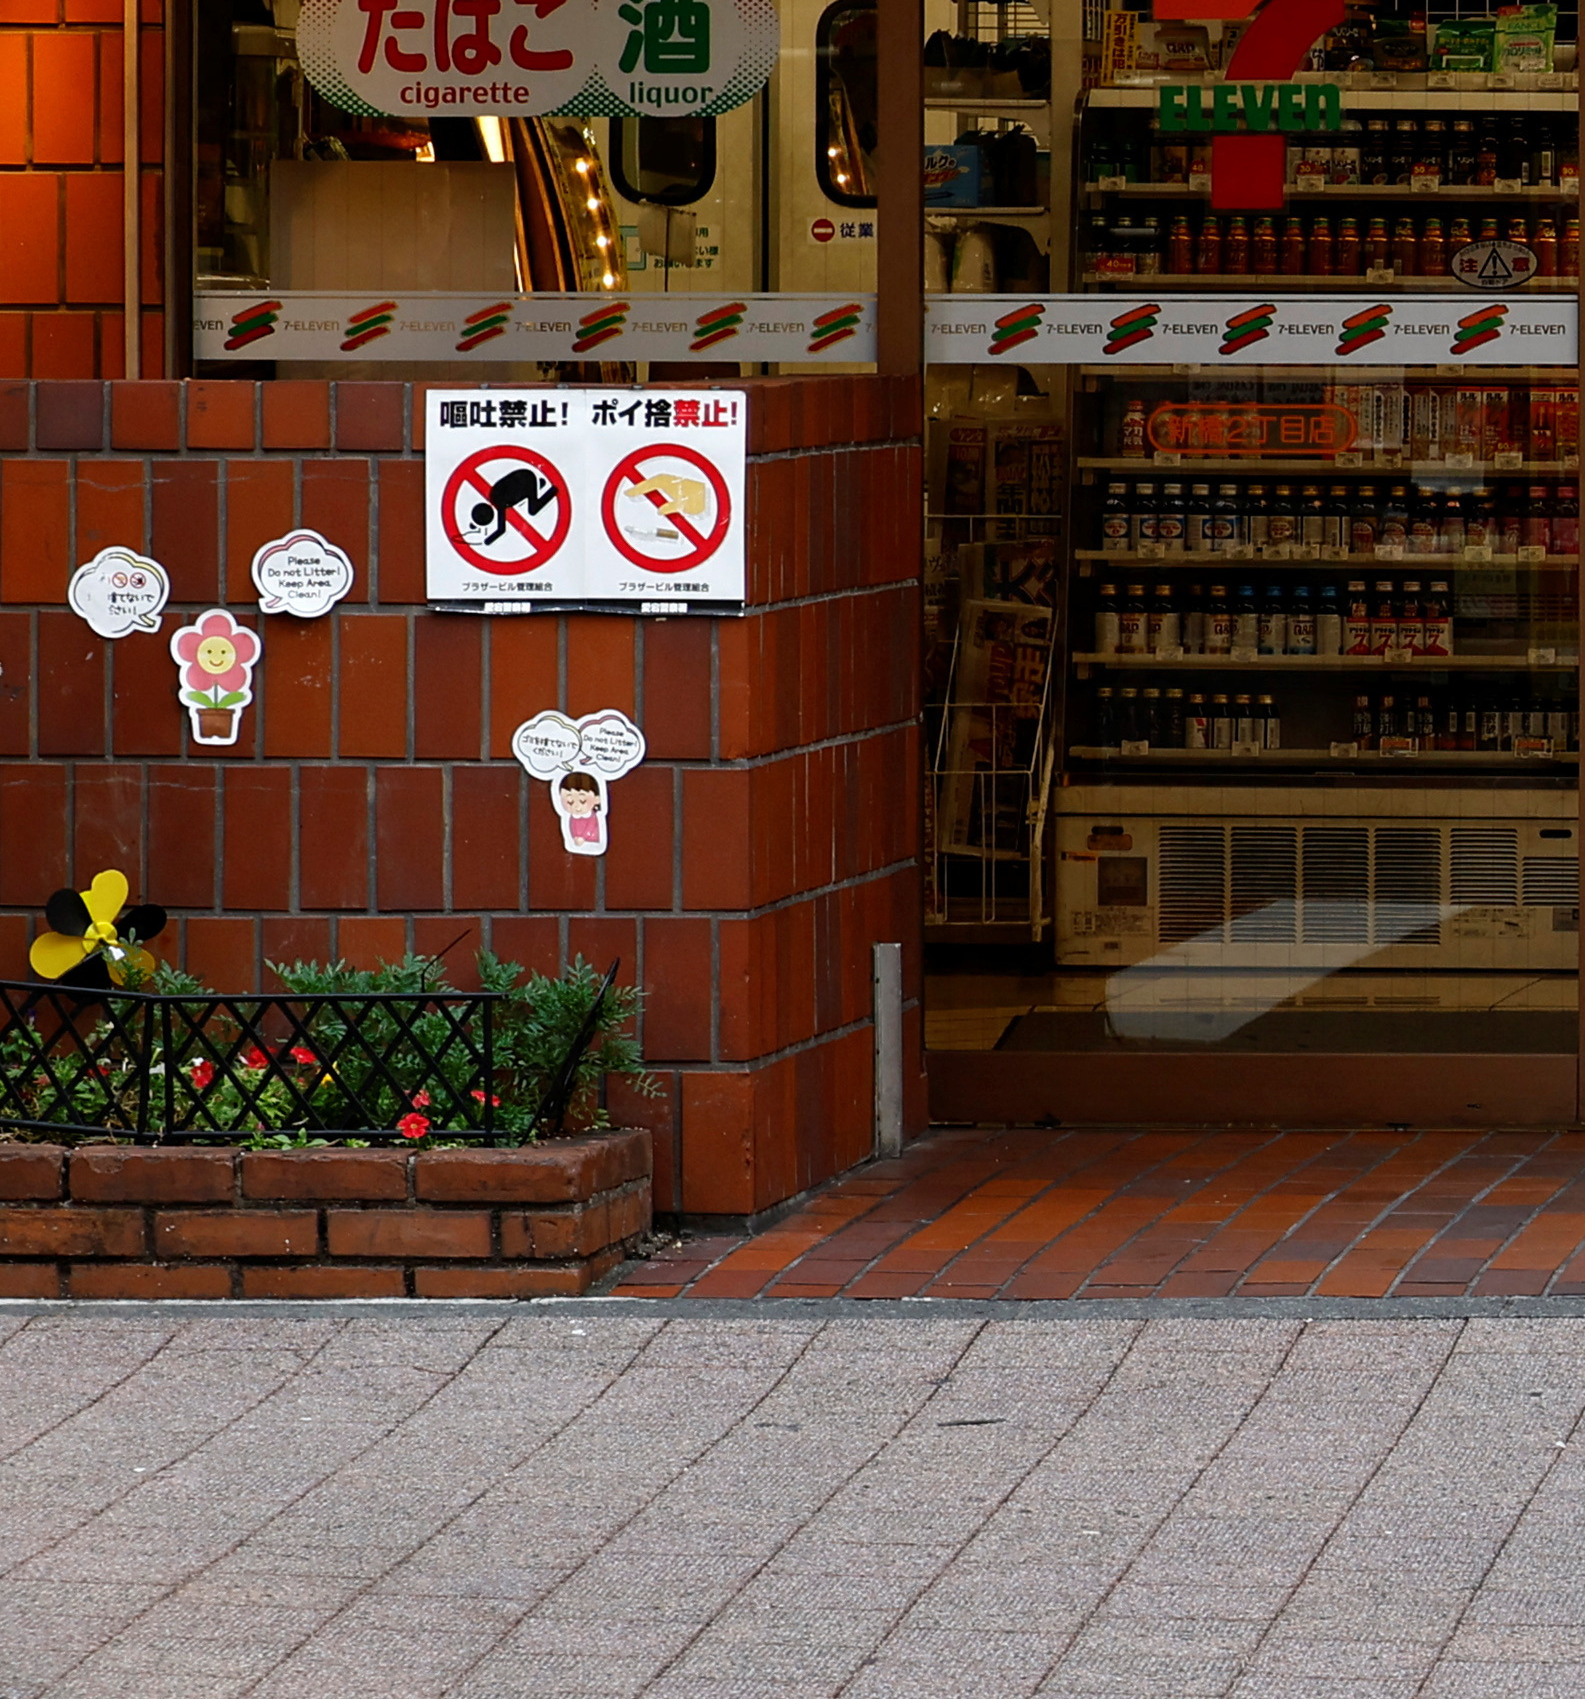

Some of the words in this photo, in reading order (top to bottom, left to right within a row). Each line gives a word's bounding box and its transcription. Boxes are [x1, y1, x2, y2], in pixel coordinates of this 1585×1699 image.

[400, 81, 530, 108] cigarette
[629, 81, 715, 109] liquor
[1459, 257, 1478, 273] 注
[439, 400, 569, 428] 嘔吐禁止!
[592, 399, 738, 428] ポイ捨禁止!
[1166, 413, 1337, 446] 新橋2丁目店
[287, 555, 321, 566] Please
[268, 568, 283, 578] Do
[284, 568, 302, 578] not
[279, 579, 304, 590] Keep
[462, 582, 553, 593] ブラザービル管理組合
[618, 582, 710, 593] ブラザービル管理組合
[287, 589, 322, 599] Clean!
